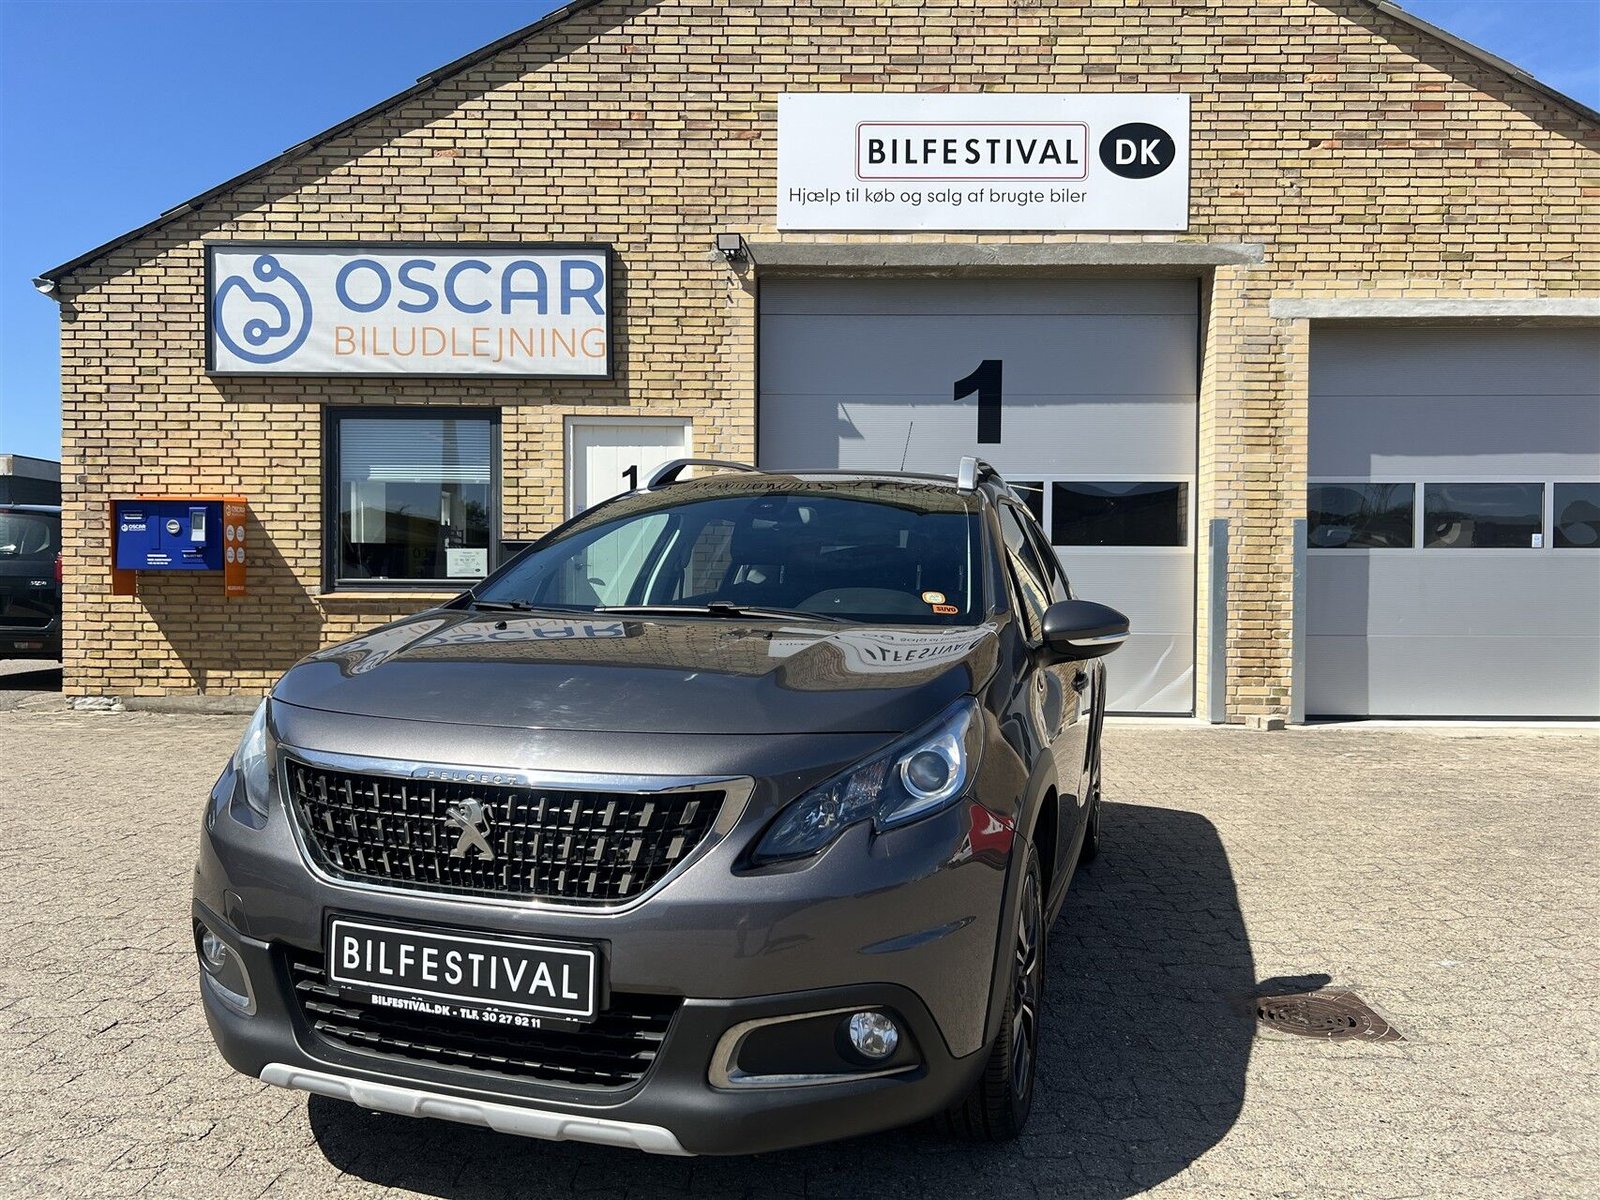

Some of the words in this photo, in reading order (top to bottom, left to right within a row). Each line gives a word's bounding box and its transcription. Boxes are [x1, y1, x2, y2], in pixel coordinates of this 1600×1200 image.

[868, 138, 1079, 165] BILFESTIVAL
[1115, 138, 1162, 166] DK
[789, 187, 841, 206] Hjælp
[845, 187, 860, 204] til
[865, 187, 896, 204] køb
[900, 191, 922, 206] og
[927, 187, 962, 206] salg
[967, 187, 985, 204] af
[989, 188, 1045, 207] brugte
[1050, 188, 1088, 205] biler
[335, 259, 605, 316] OSCAR
[334, 325, 606, 363] BILUDLEJNING
[953, 359, 1003, 444] 1
[622, 465, 638, 490] 1
[427, 769, 518, 785] PEUGEOT
[343, 936, 579, 1000] BILFESTIVAL
[371, 994, 451, 1016] BILFESTIVAL.DK
[482, 1011, 497, 1023] 30
[499, 1013, 513, 1025] 27
[514, 1015, 530, 1027] 92
[531, 1017, 542, 1029] 11
